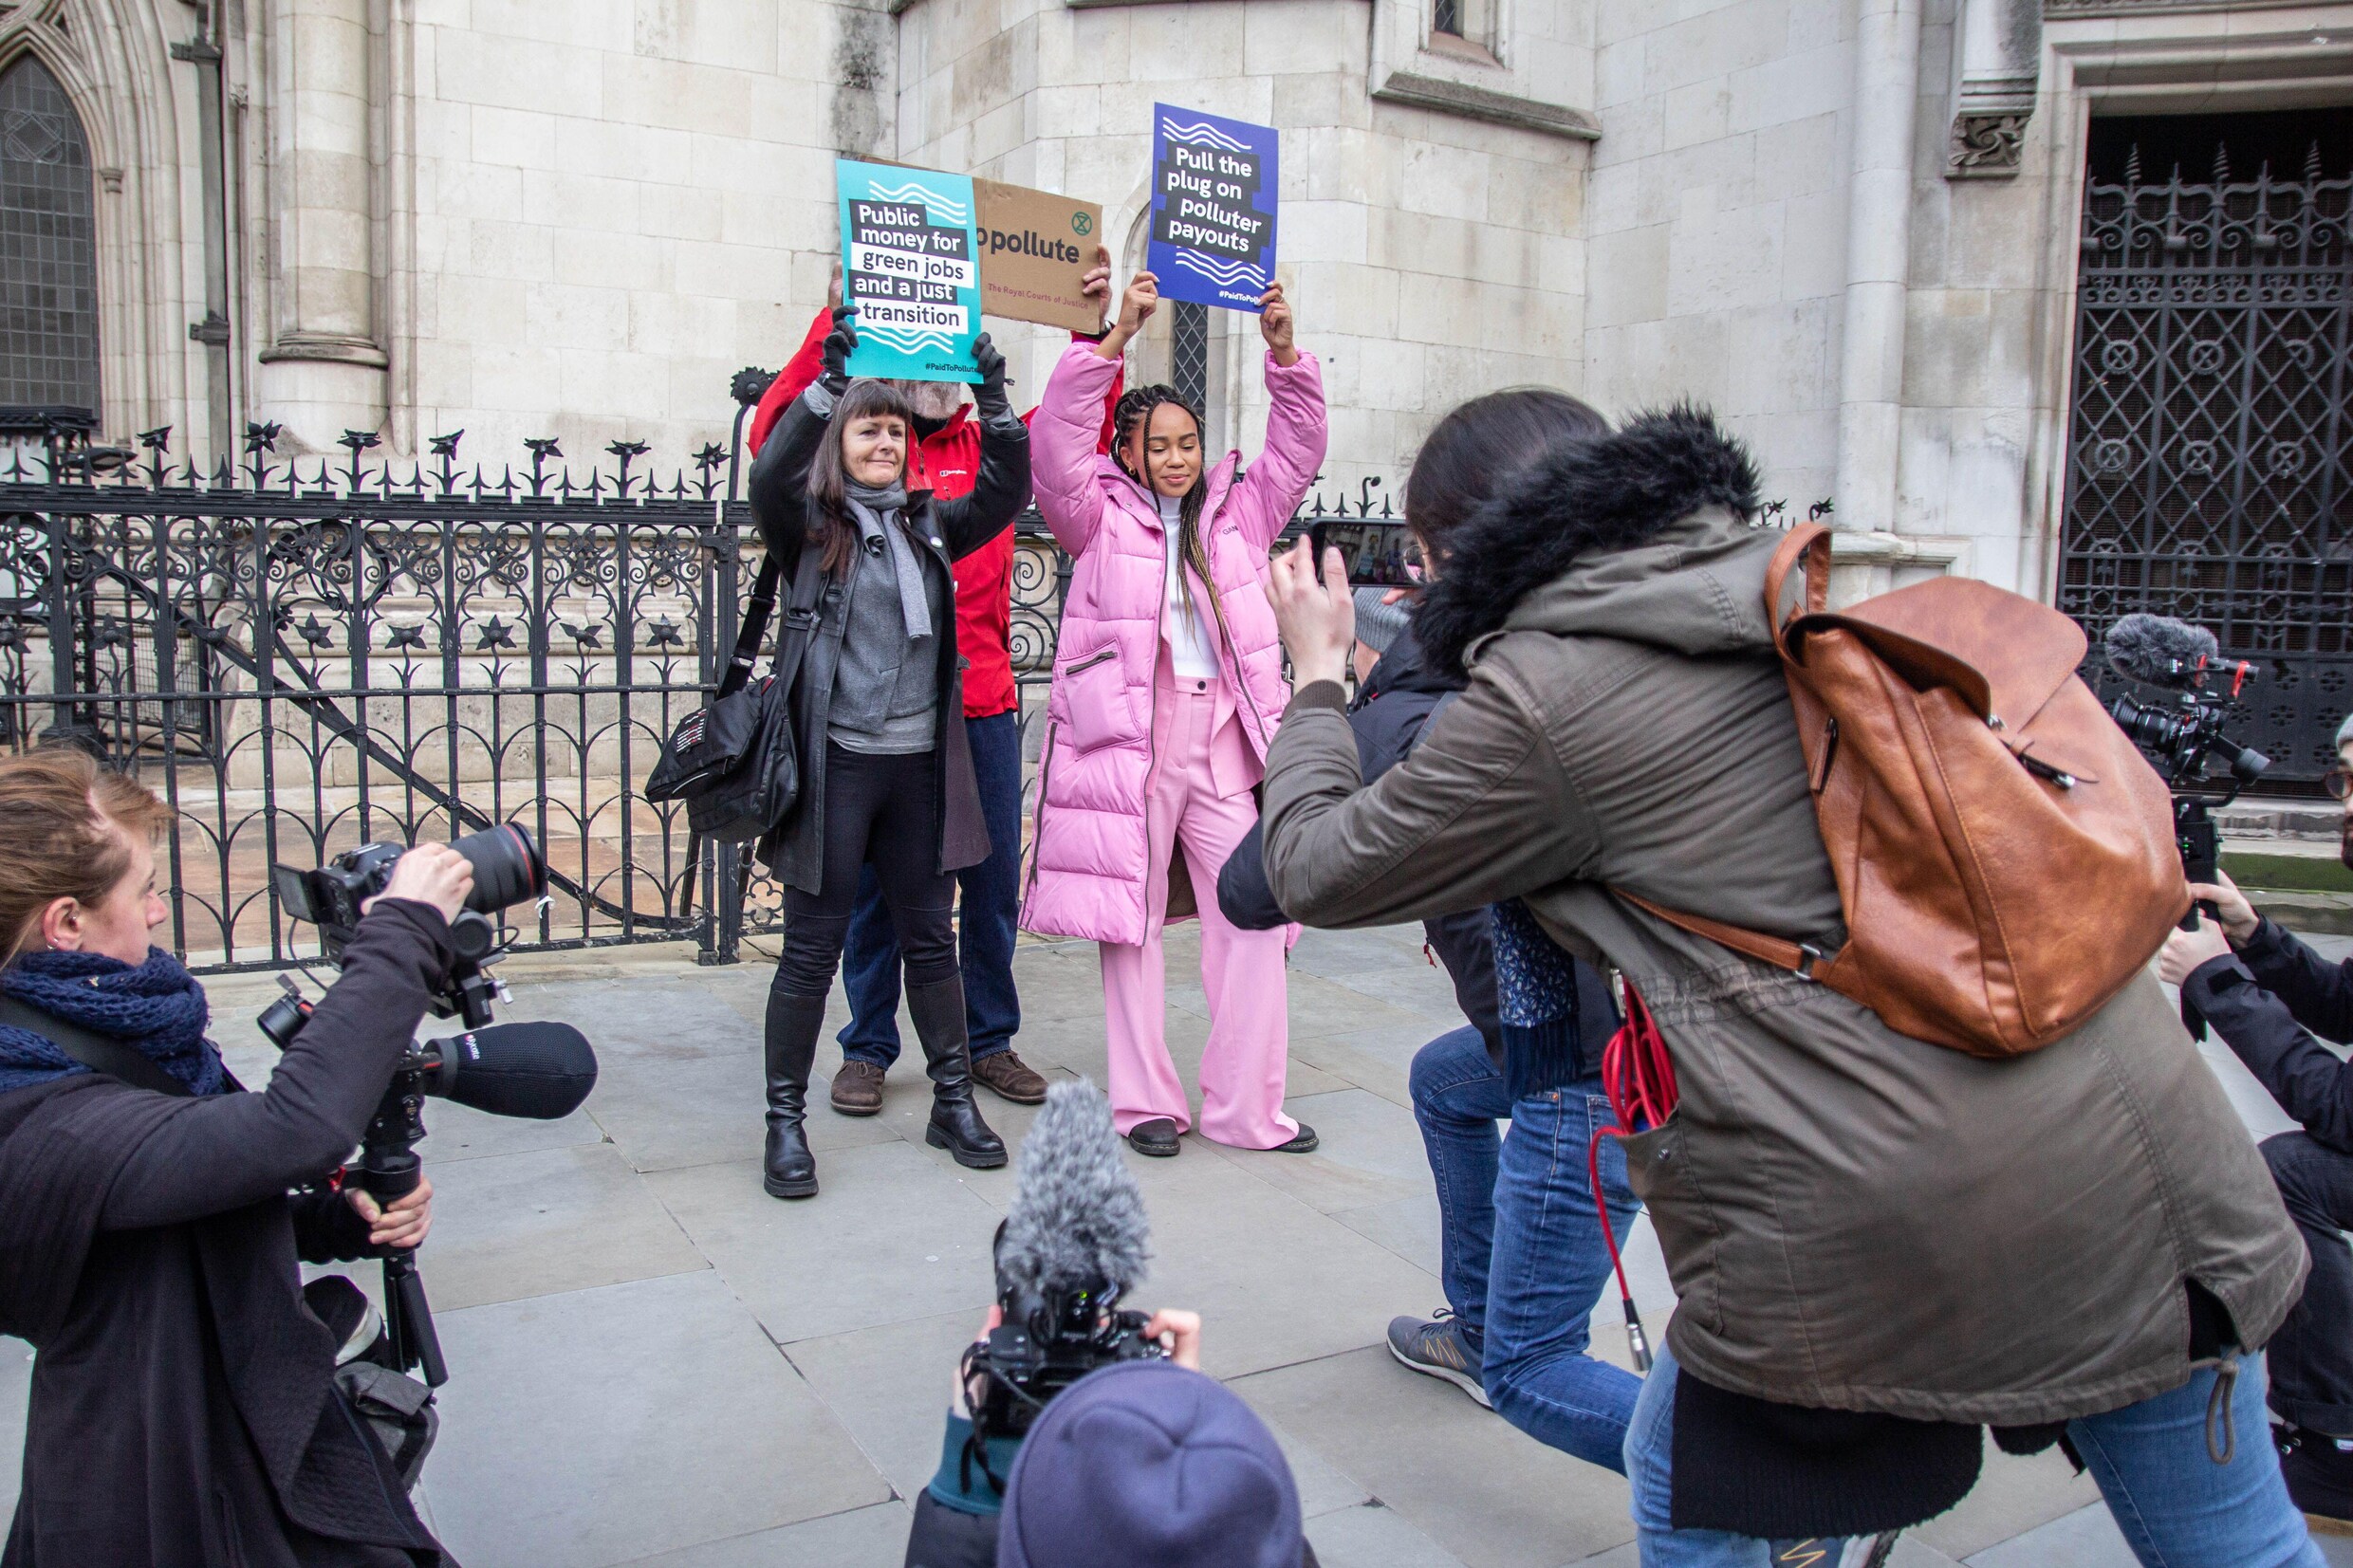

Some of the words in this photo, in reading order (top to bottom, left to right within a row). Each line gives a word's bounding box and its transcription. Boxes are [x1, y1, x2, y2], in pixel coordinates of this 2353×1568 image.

[1176, 147, 1214, 172] Pull
[1218, 156, 1252, 177] the
[1167, 170, 1212, 198] plug
[1216, 182, 1242, 199] on
[859, 204, 920, 227] Public
[1180, 197, 1262, 233] polluter
[861, 228, 928, 253] money
[932, 231, 961, 251] for
[991, 230, 1080, 264] pollute
[1168, 219, 1250, 252] payouts
[862, 250, 918, 273] green
[924, 256, 964, 280] jobs
[855, 276, 893, 295] and
[899, 281, 910, 296] a
[915, 279, 954, 302] just
[988, 283, 1002, 293] The
[1003, 286, 1025, 298] Royal
[1026, 290, 1052, 303] Courts
[1062, 297, 1089, 310] Justice
[862, 302, 960, 326] transition
